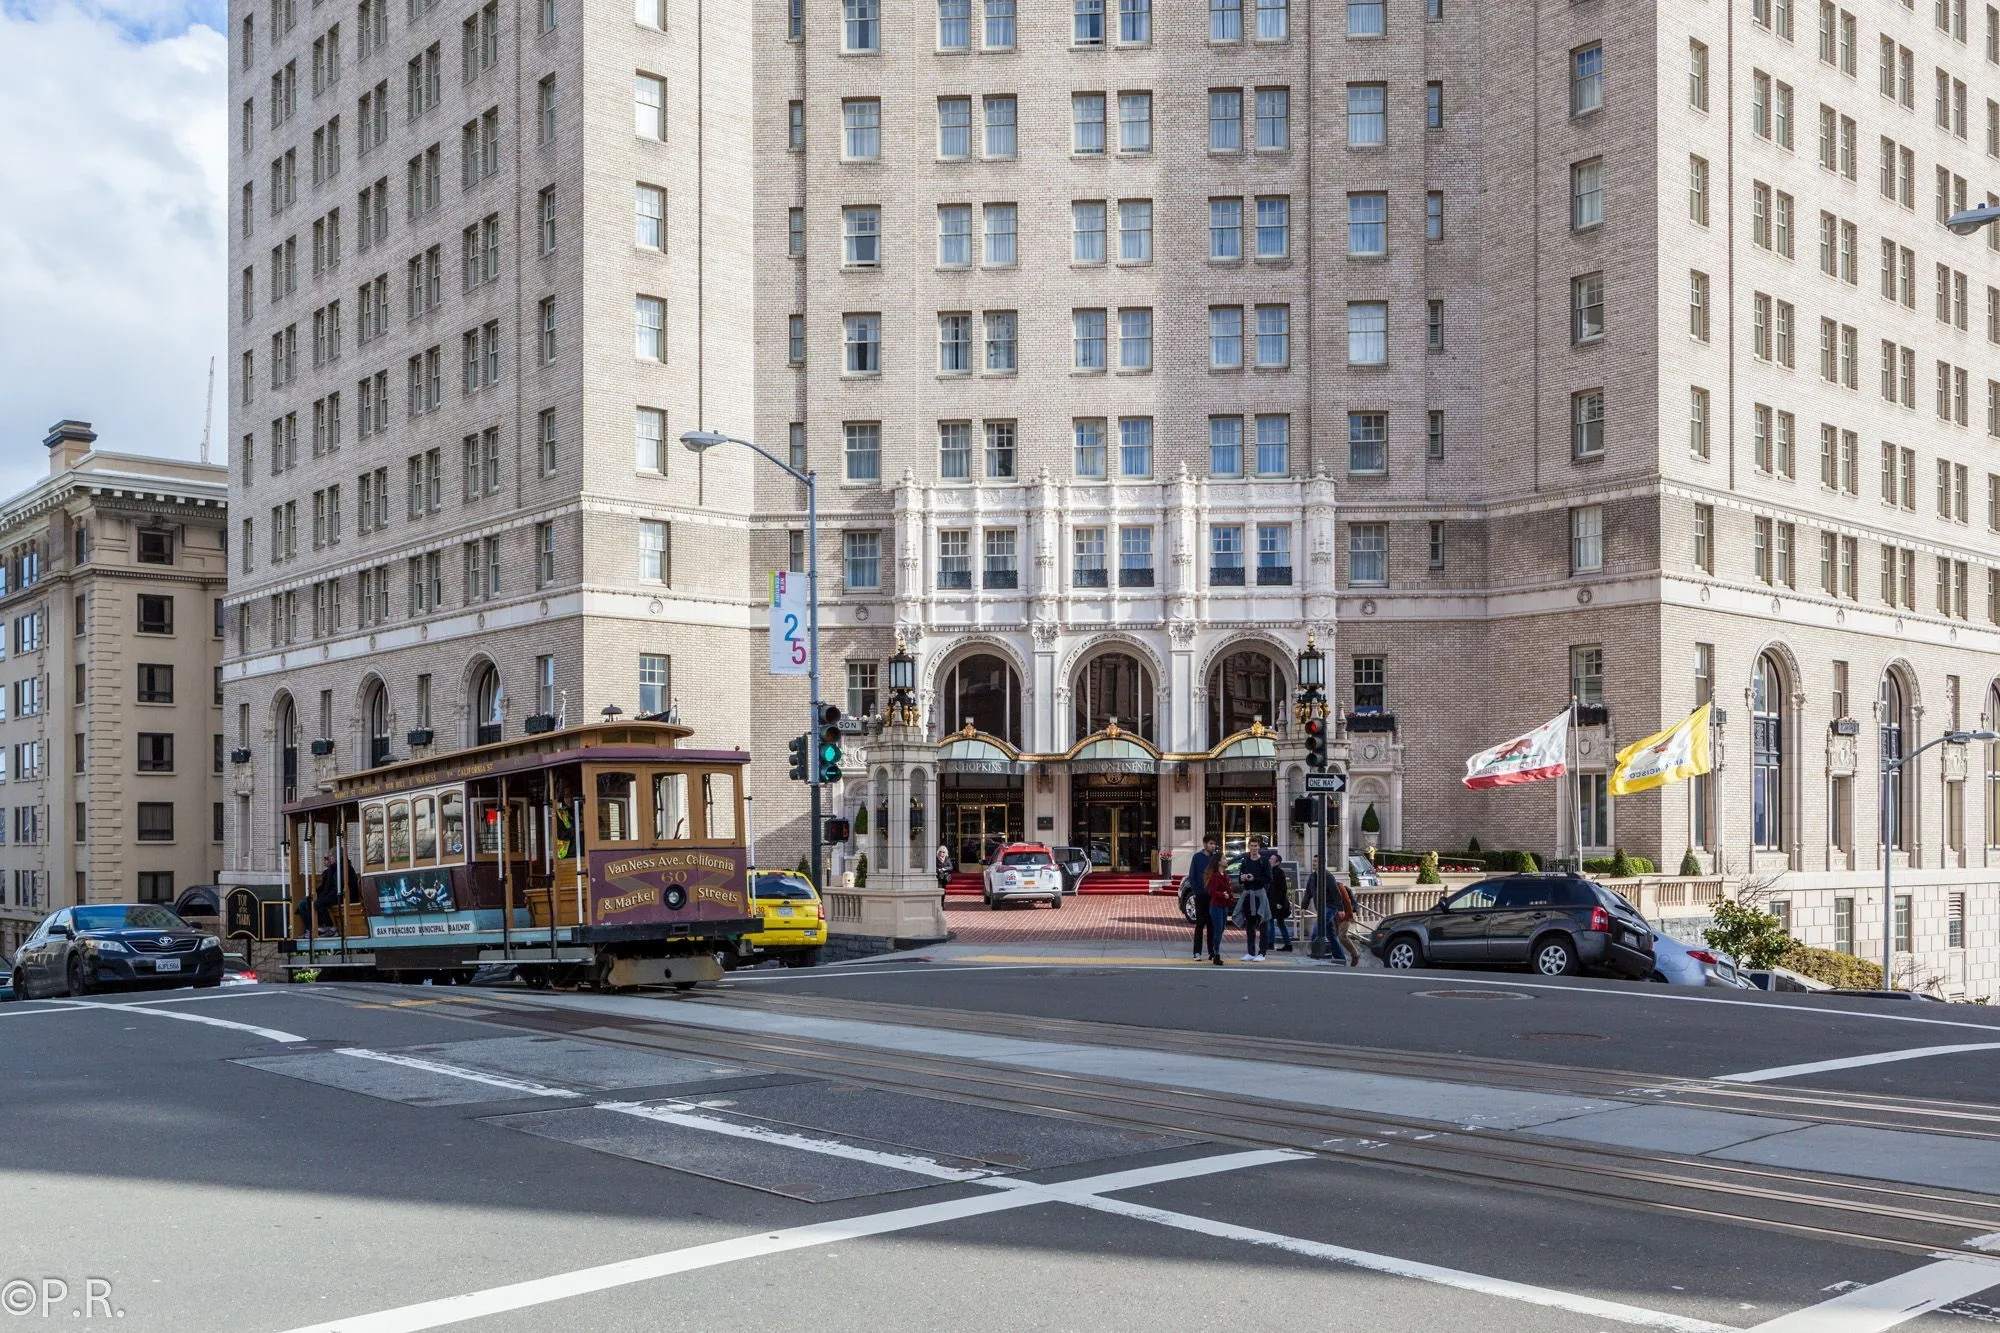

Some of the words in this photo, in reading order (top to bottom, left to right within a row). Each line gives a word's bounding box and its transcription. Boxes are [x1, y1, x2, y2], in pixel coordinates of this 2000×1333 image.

[839, 721, 857, 729] SON
[1310, 779, 1321, 787] ONE
[1322, 779, 1335, 787] WAY
[686, 854, 734, 871] California
[661, 871, 687, 883] 60
[604, 898, 613, 910] &
[614, 890, 655, 909] Market
[698, 887, 738, 902] Streets
[376, 927, 388, 936] SAN
[388, 926, 416, 935] FRANCISCO
[419, 924, 445, 934] MUNICIPAL
[447, 923, 471, 932] RAILWAY
